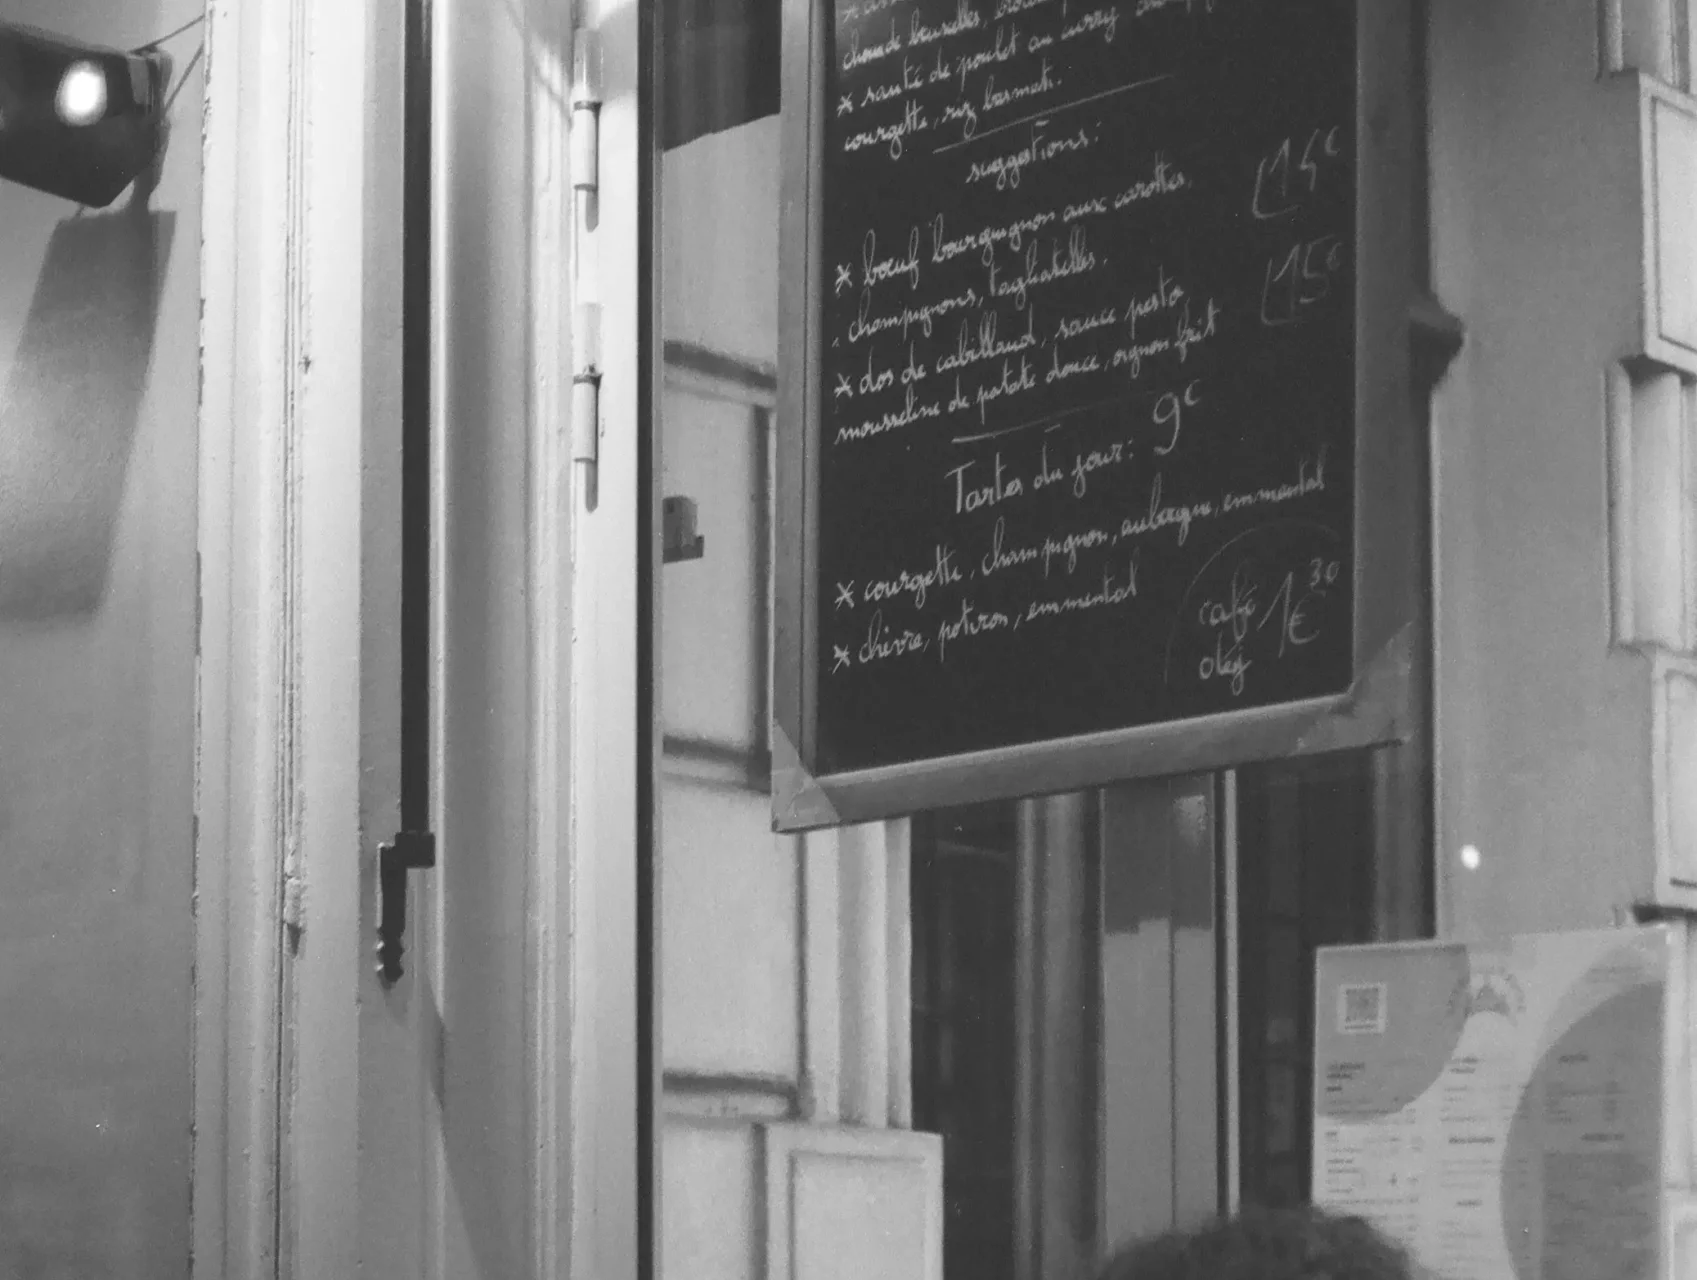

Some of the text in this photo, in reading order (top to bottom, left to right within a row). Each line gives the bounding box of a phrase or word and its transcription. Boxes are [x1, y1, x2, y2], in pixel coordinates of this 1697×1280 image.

[929, 46, 951, 83] de
[956, 22, 1020, 93] poulet
[1028, 35, 1053, 53] au
[1061, 6, 1119, 43] curry
[942, 101, 976, 140] riz
[931, 212, 1055, 267] bourguignon
[1063, 197, 1107, 223] aux
[860, 345, 894, 395] dos
[900, 340, 927, 384] de
[1055, 316, 1116, 340] sauce
[1124, 263, 1185, 341] pesto
[835, 382, 941, 446] mousseline
[948, 374, 970, 413] de
[977, 354, 1036, 426] patate
[1112, 340, 1169, 380] oignon
[1034, 441, 1064, 490] du
[1025, 546, 1139, 622] emmental
